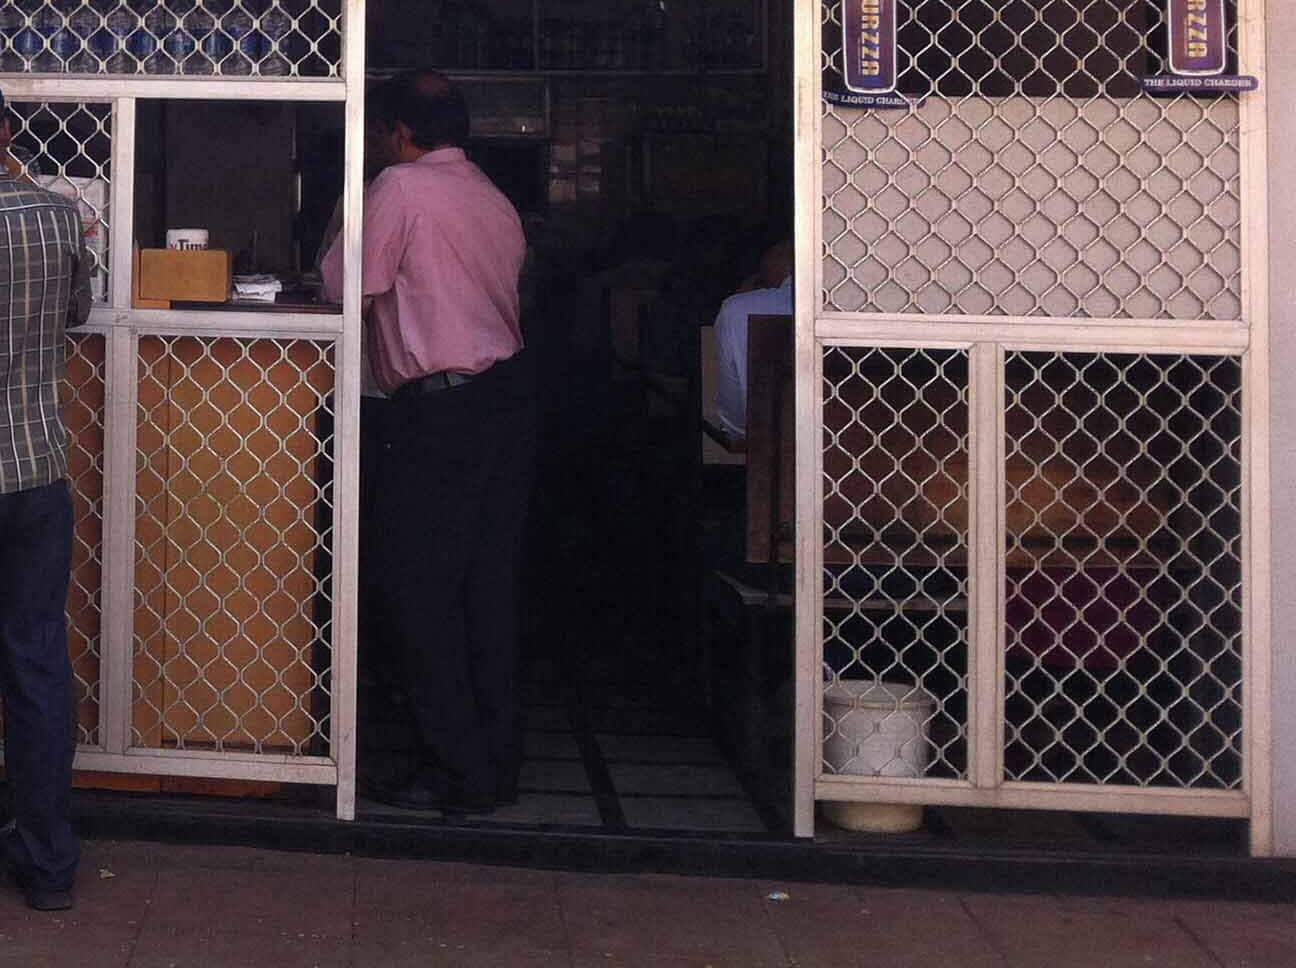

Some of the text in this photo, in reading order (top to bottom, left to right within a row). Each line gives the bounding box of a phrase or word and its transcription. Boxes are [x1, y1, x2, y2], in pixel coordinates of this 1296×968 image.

[1144, 78, 1162, 87] THE
[1165, 78, 1203, 87] LIQUID
[841, 94, 874, 104] LIQUID
